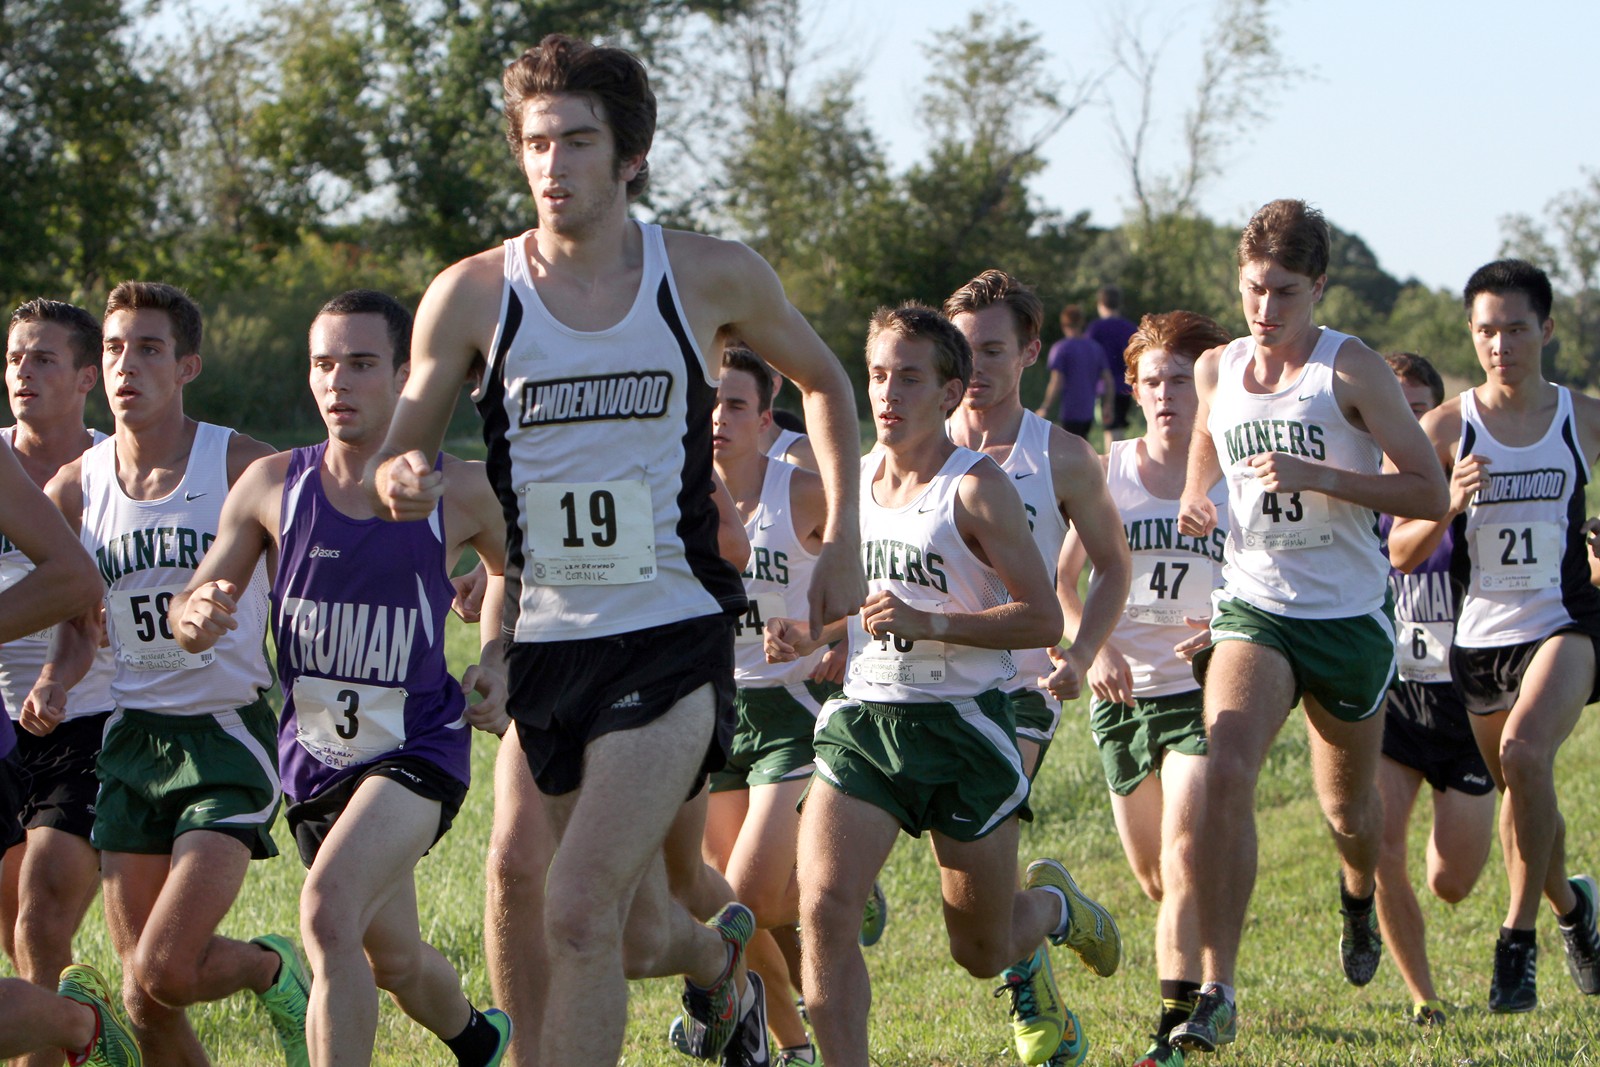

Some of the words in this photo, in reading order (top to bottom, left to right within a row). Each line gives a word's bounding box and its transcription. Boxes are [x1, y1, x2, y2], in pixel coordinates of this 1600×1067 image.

[522, 375, 670, 424] LINDENWOOD
[1224, 419, 1326, 466] MINERS
[560, 489, 617, 548] 19
[1262, 491, 1304, 523] 43
[861, 539, 948, 594] INERS
[1499, 527, 1538, 566] 21
[1150, 562, 1189, 600] 47
[285, 596, 418, 683] TRUMAN
[1412, 627, 1427, 660] 6
[146, 657, 188, 670] BINDER
[335, 689, 360, 740] 3
